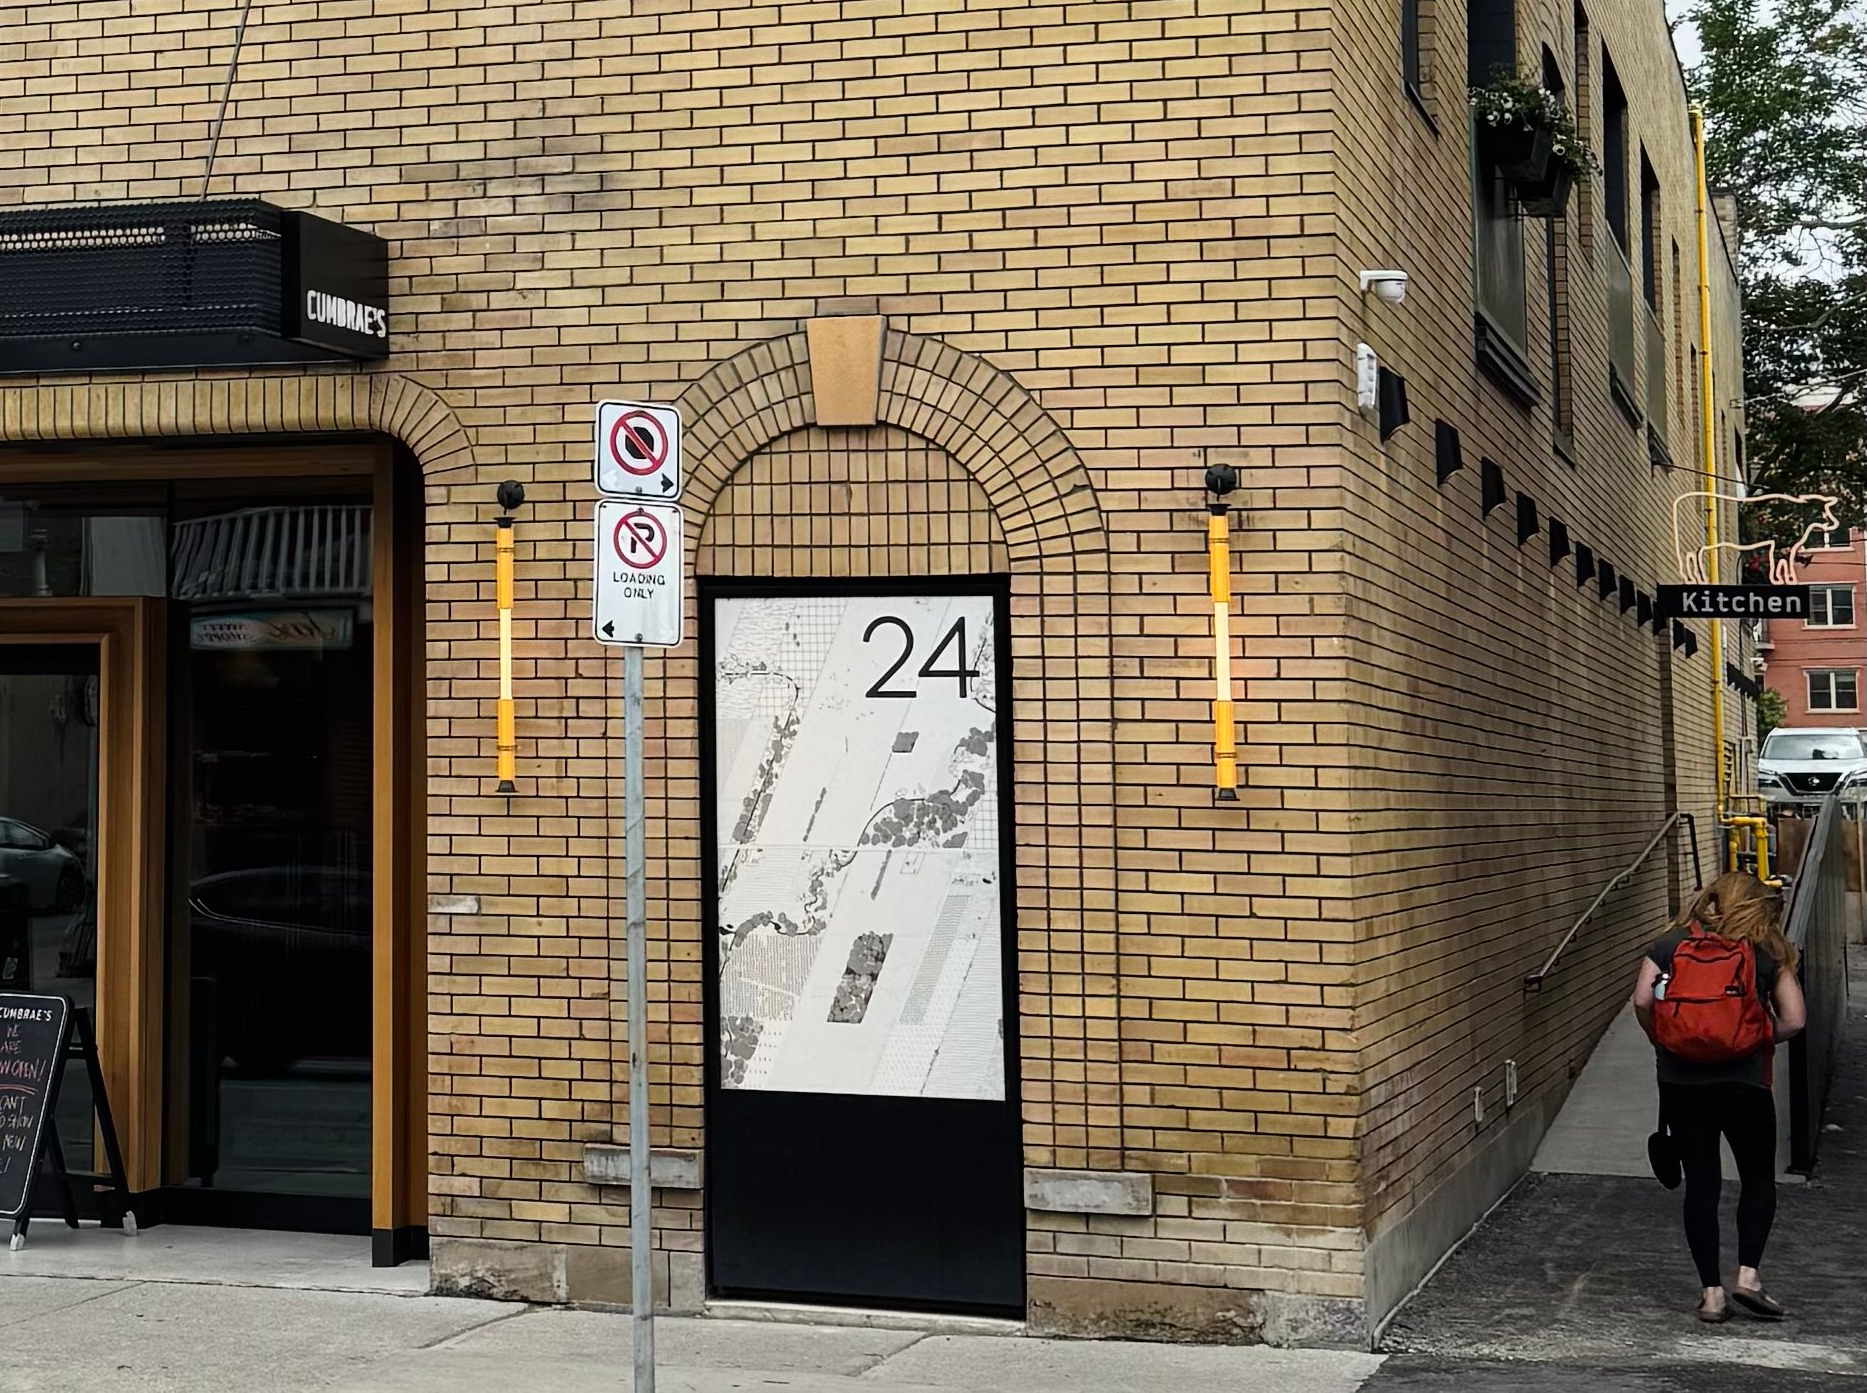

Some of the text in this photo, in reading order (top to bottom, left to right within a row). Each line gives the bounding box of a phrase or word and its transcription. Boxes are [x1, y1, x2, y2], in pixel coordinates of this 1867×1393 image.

[306, 289, 387, 338] CUMBRAE'S
[612, 571, 666, 586] LOADING
[623, 586, 655, 600] ONLY
[1682, 590, 1802, 614] Kitchen
[861, 614, 980, 700] 24
